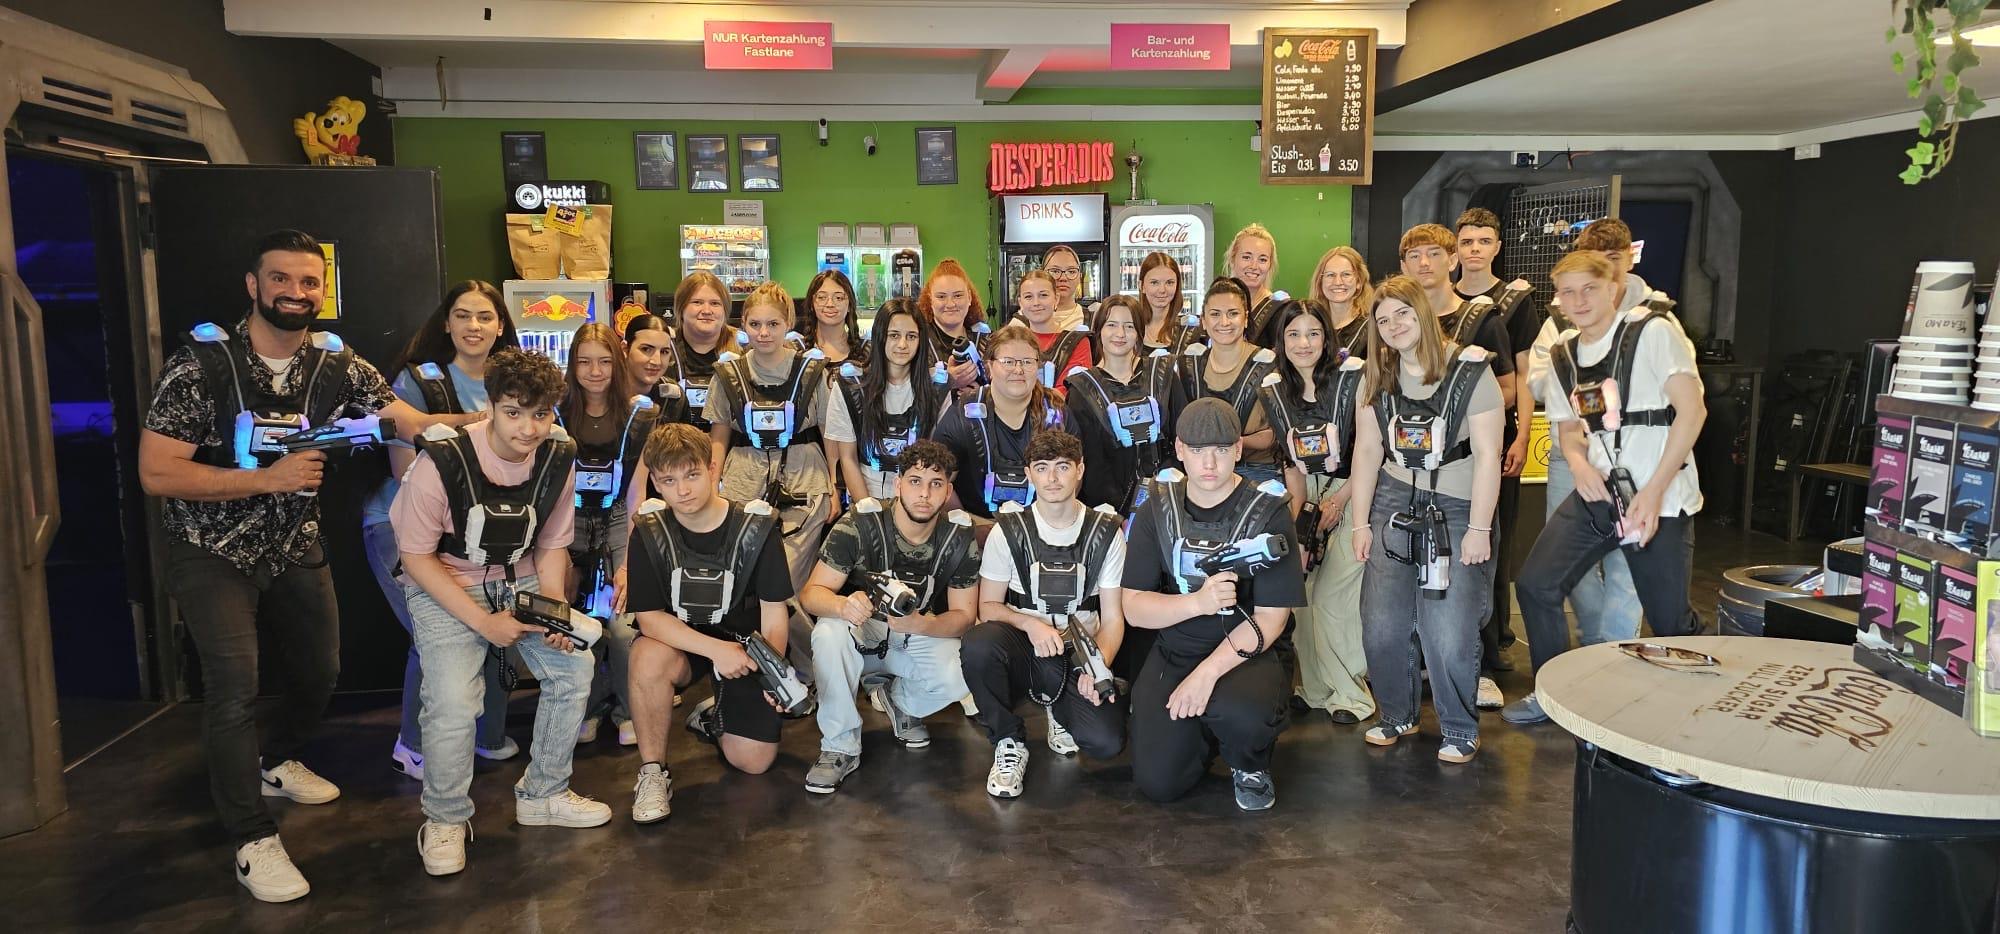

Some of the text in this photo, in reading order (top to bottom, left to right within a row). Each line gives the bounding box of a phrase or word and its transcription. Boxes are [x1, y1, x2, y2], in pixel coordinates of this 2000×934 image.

[712, 33, 826, 47] NUR Kartenzahlung
[1147, 35, 1195, 45] Bar- und
[1298, 39, 1342, 55] Coca-Cola
[744, 46, 794, 57] Fastlane
[1131, 48, 1211, 60] Kartenzahlung
[1276, 100, 1290, 109] Bier
[1271, 144, 1304, 159] Slush-
[989, 141, 1115, 191] DESPERADOS
[1271, 160, 1287, 174] Eis
[542, 184, 586, 199] kukki
[1020, 201, 1074, 220] DRINKS
[1128, 222, 1192, 243] Coca-Cola
[1707, 662, 1787, 714] NULL ZUCKER
[1733, 664, 1816, 721] ZERO SUGAR
